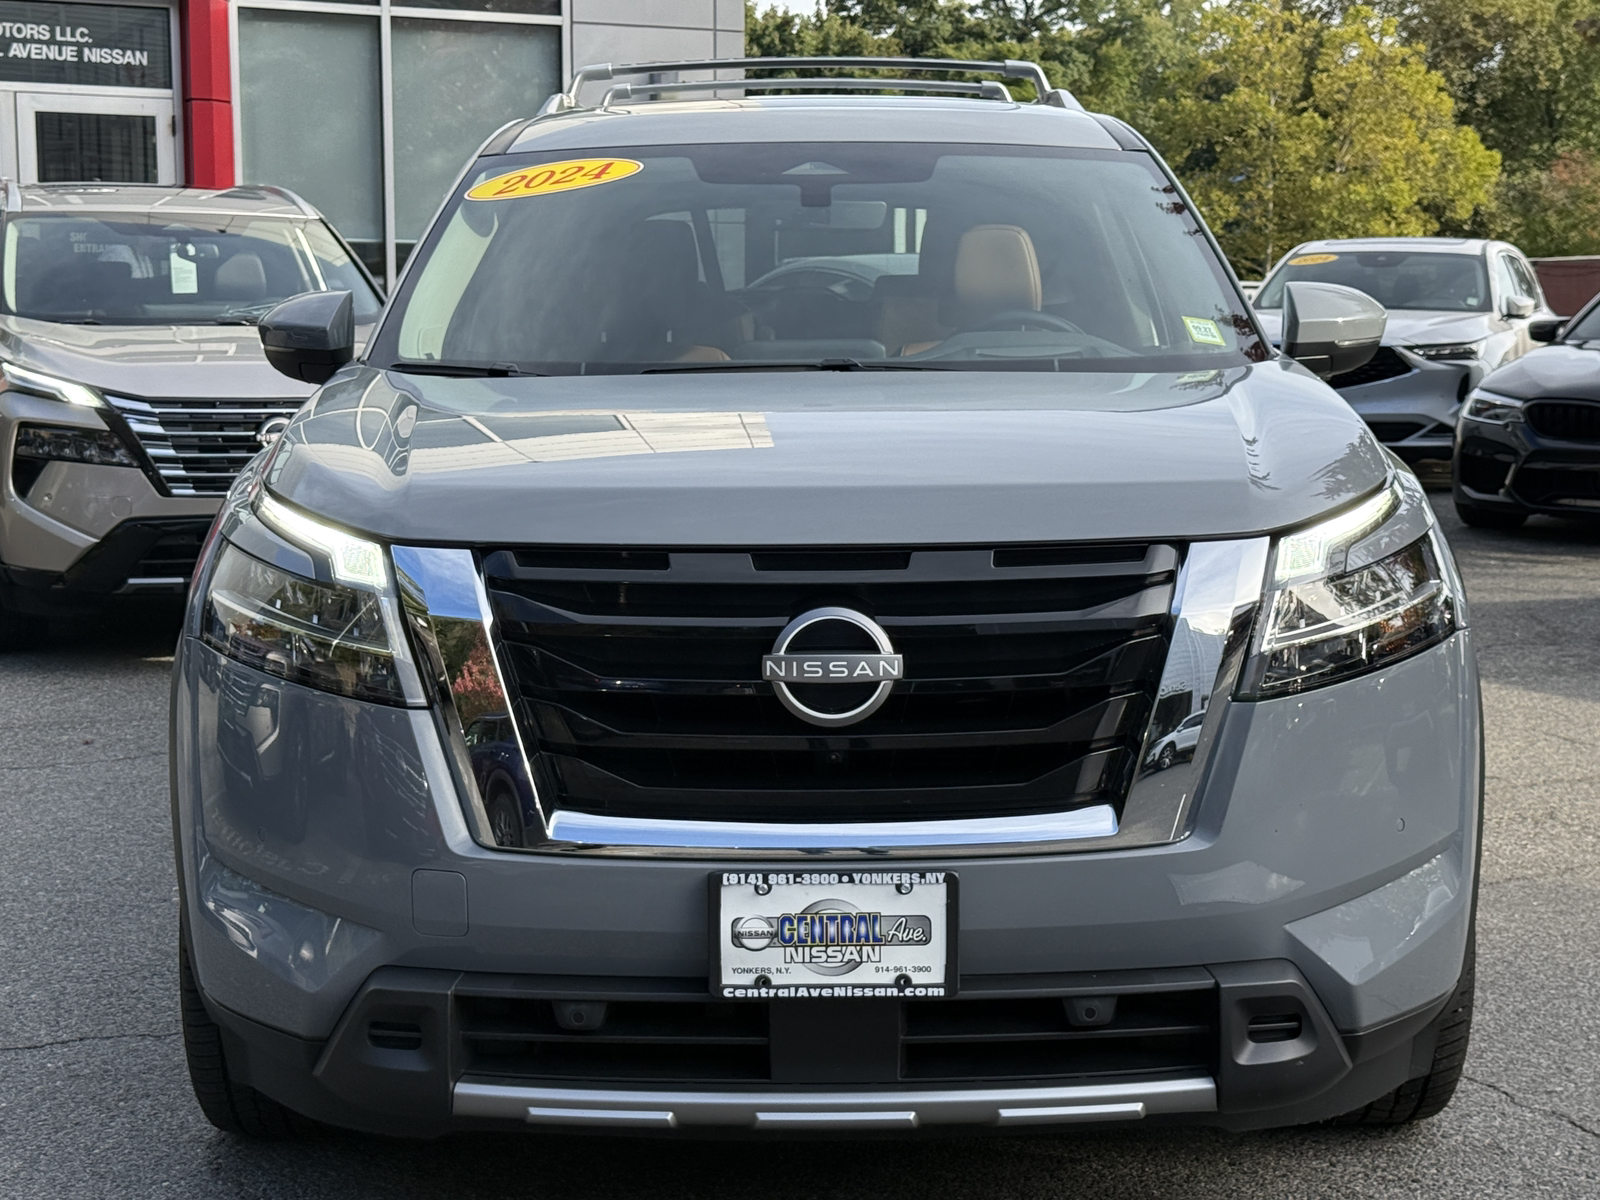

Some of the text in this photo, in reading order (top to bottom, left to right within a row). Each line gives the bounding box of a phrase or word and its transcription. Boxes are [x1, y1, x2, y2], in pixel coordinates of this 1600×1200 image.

[0, 22, 93, 43] TORS LLC.
[8, 42, 149, 67] AVENUE NISSAN
[492, 161, 616, 197] 2024
[765, 660, 899, 677] NISSAN
[768, 873, 839, 885] 961-3900
[778, 912, 927, 946] CENTRAL Ave.
[784, 946, 882, 963] NISSAN
[731, 967, 792, 975] YONKERS, N.Y.
[722, 986, 945, 998] CentralAveNissan.com
